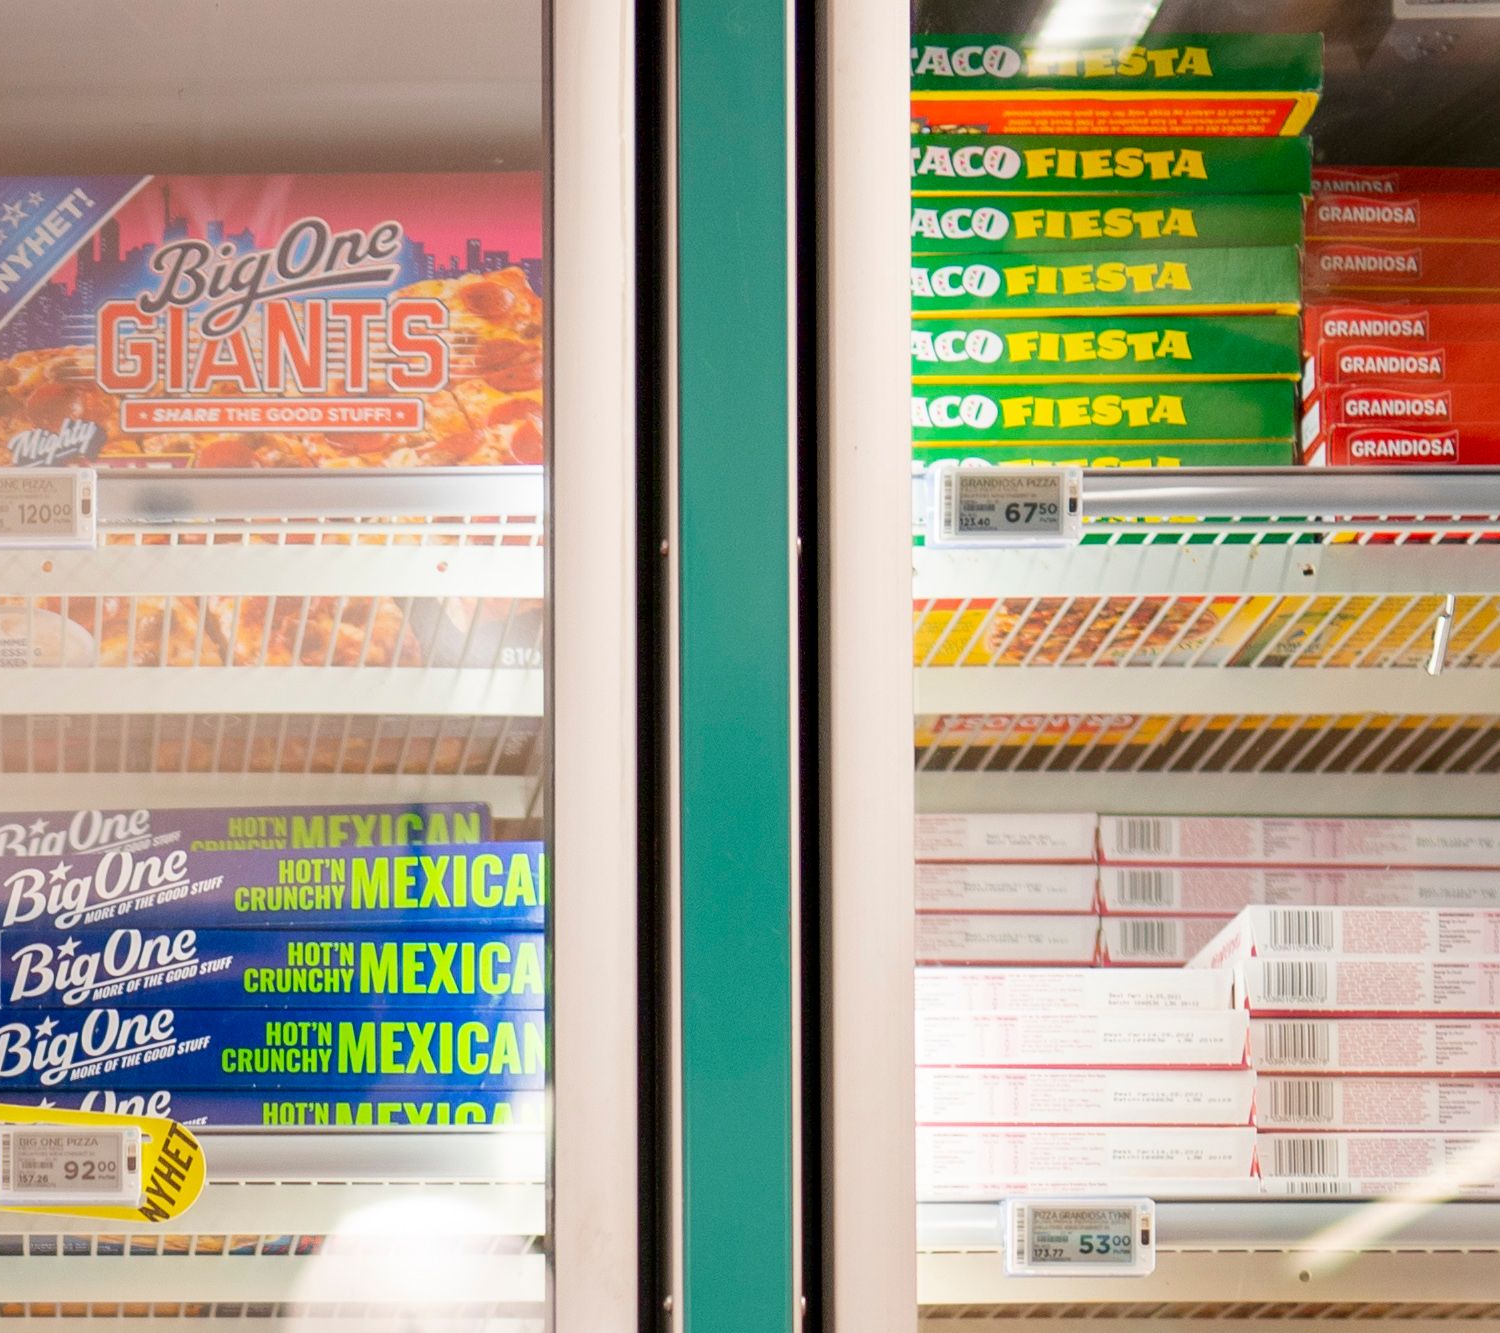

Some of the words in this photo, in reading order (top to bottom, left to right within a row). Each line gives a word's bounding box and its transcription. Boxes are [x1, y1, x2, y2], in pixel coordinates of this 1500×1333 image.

[1024, 148, 1208, 180] FIESTA
[139, 237, 269, 338] Big
[277, 216, 401, 280] One
[97, 298, 449, 394] GIANTS
[153, 408, 220, 423] SHARE
[226, 408, 260, 423] THE
[266, 408, 323, 422] GOOD
[328, 407, 392, 422] STUFF!
[8, 420, 97, 462] Mighty
[1351, 437, 1456, 458] GRANDIOSA
[1021, 478, 1057, 489] PIZZA
[222, 1047, 332, 1073] CRUNCHY
[139, 1121, 199, 1222] NYHET
